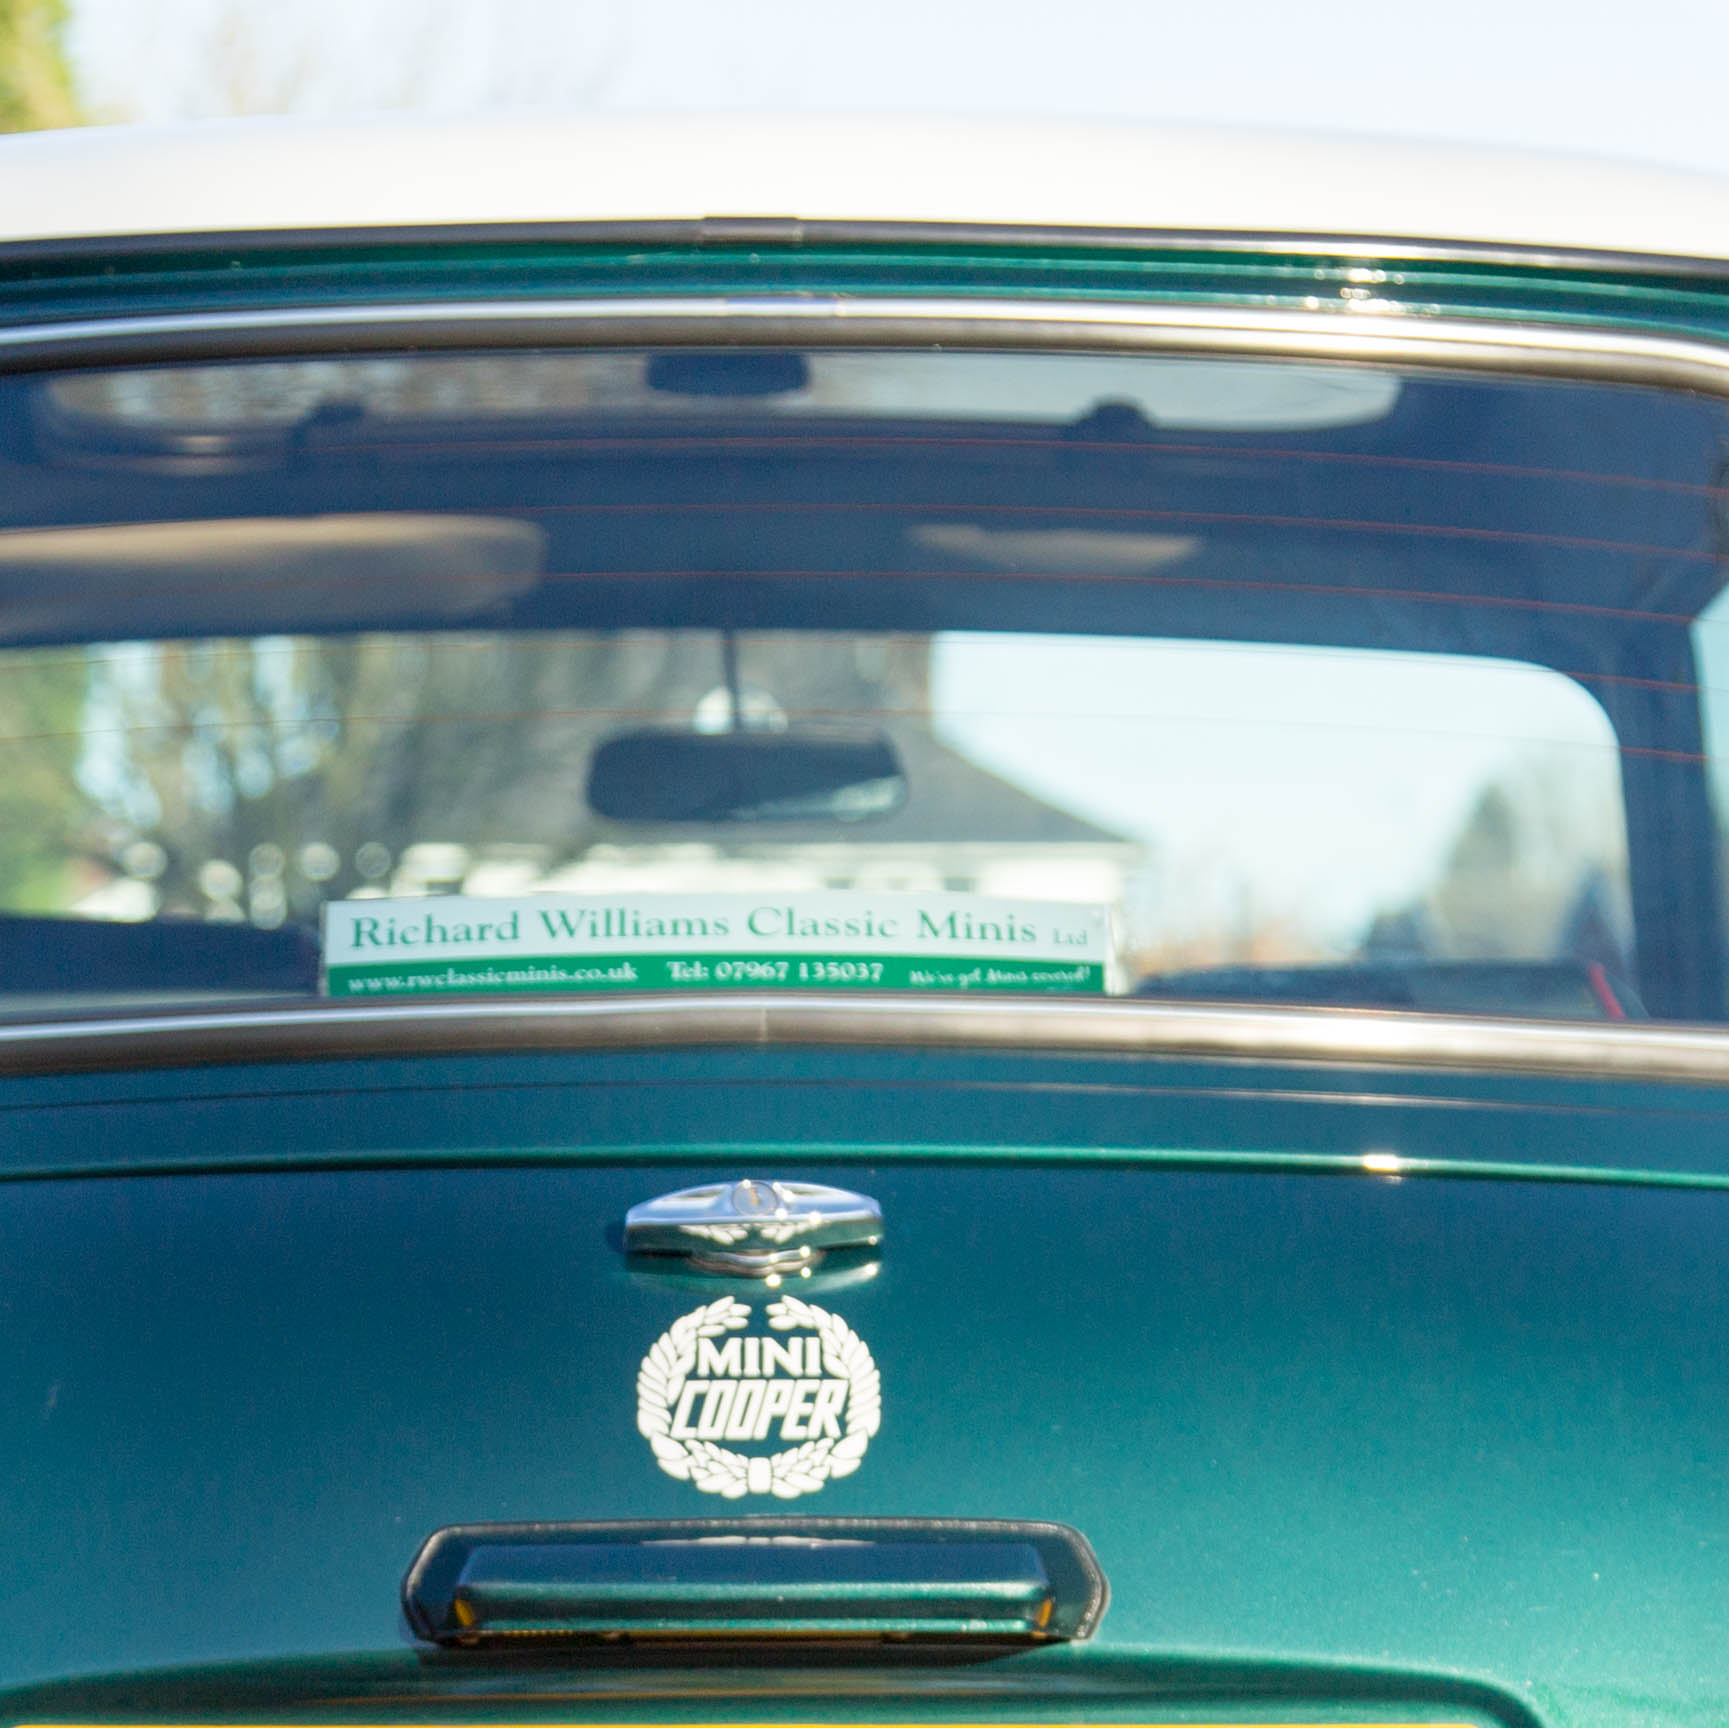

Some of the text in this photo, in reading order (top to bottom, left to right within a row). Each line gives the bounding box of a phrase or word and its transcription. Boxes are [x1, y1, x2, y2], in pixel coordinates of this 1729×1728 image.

[351, 906, 1088, 948] Richard Williams Classic Minis Ltd
[348, 962, 638, 992] www.rwclassicminis.co.uk
[667, 962, 709, 980] Tel:
[715, 962, 789, 981] 07967
[798, 962, 884, 982] 135037
[697, 1337, 823, 1377] MINI
[670, 1379, 850, 1440] COOPER
